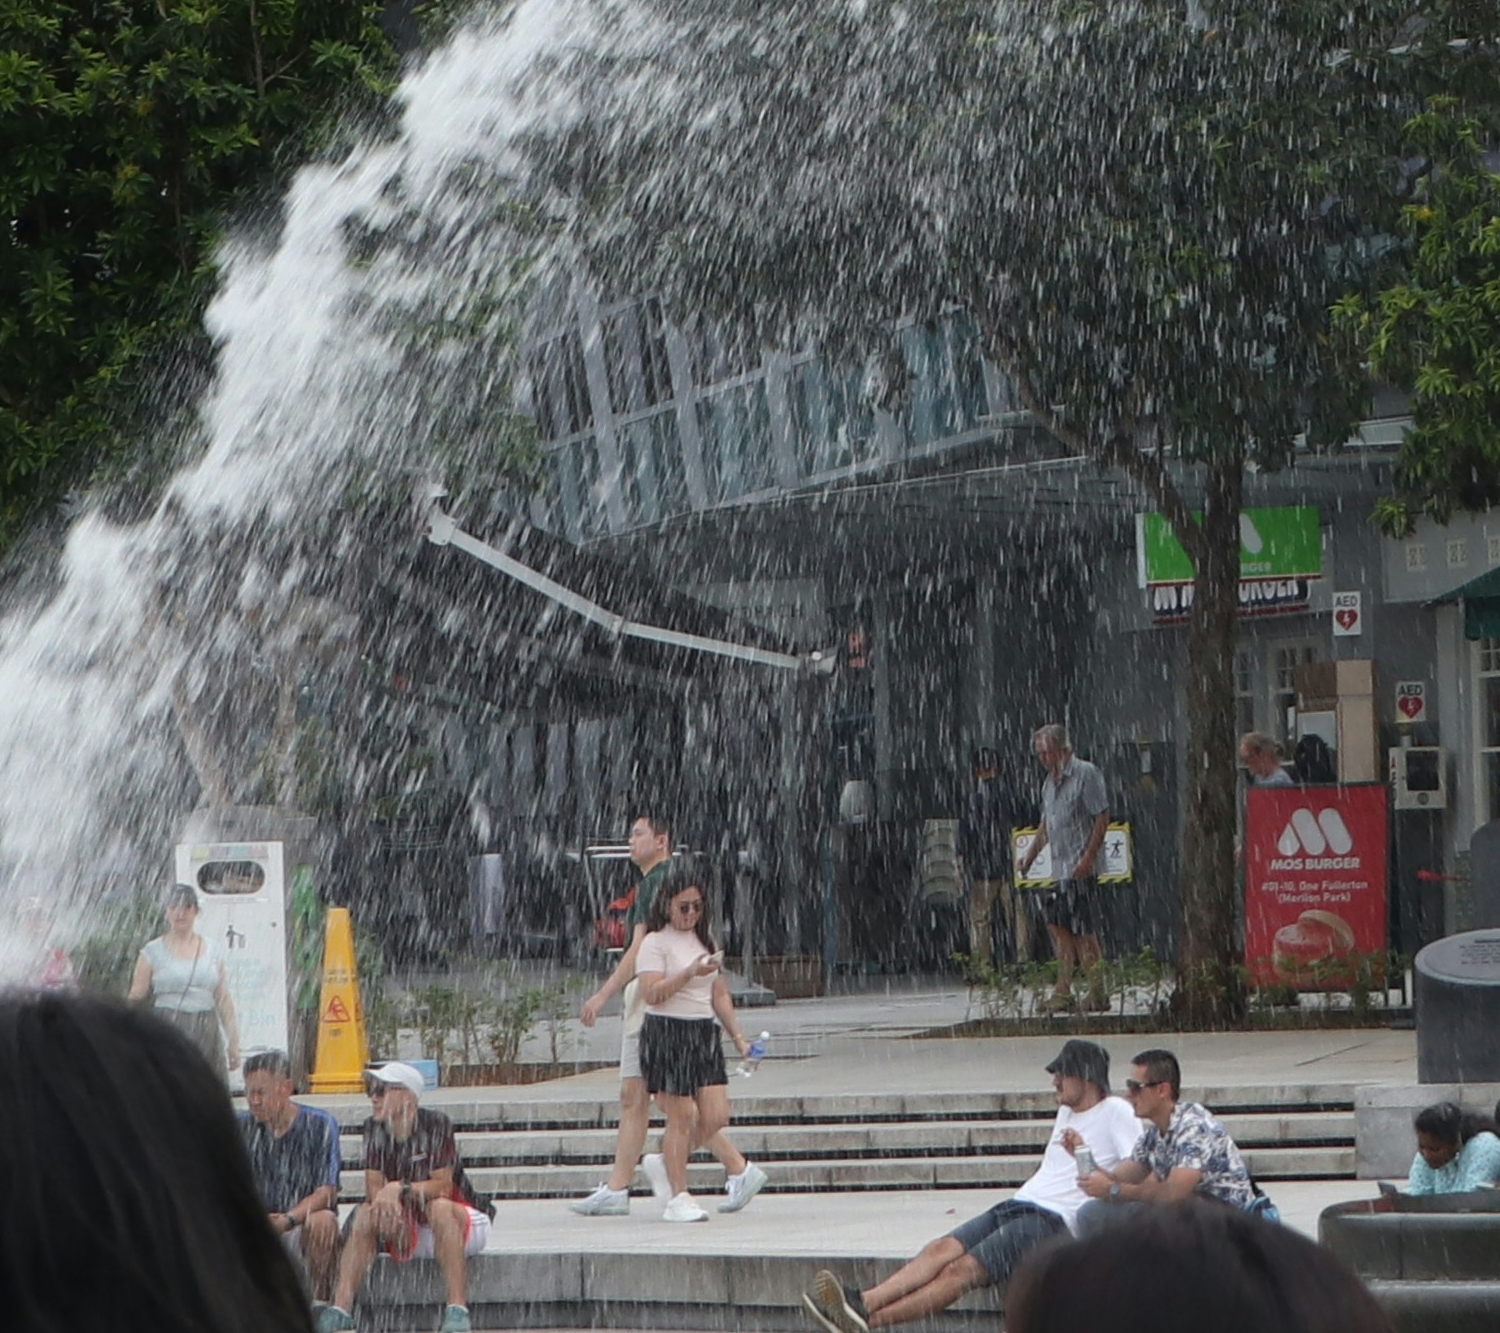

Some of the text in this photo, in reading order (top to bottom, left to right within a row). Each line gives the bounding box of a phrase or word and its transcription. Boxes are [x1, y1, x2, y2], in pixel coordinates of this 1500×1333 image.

[1335, 594, 1358, 607] AED
[1398, 683, 1423, 697] AED
[1271, 857, 1360, 871] MOS BURGER
[1299, 880, 1319, 891] One
[1322, 880, 1368, 891] Fullerton
[1323, 892, 1351, 902] Park)
